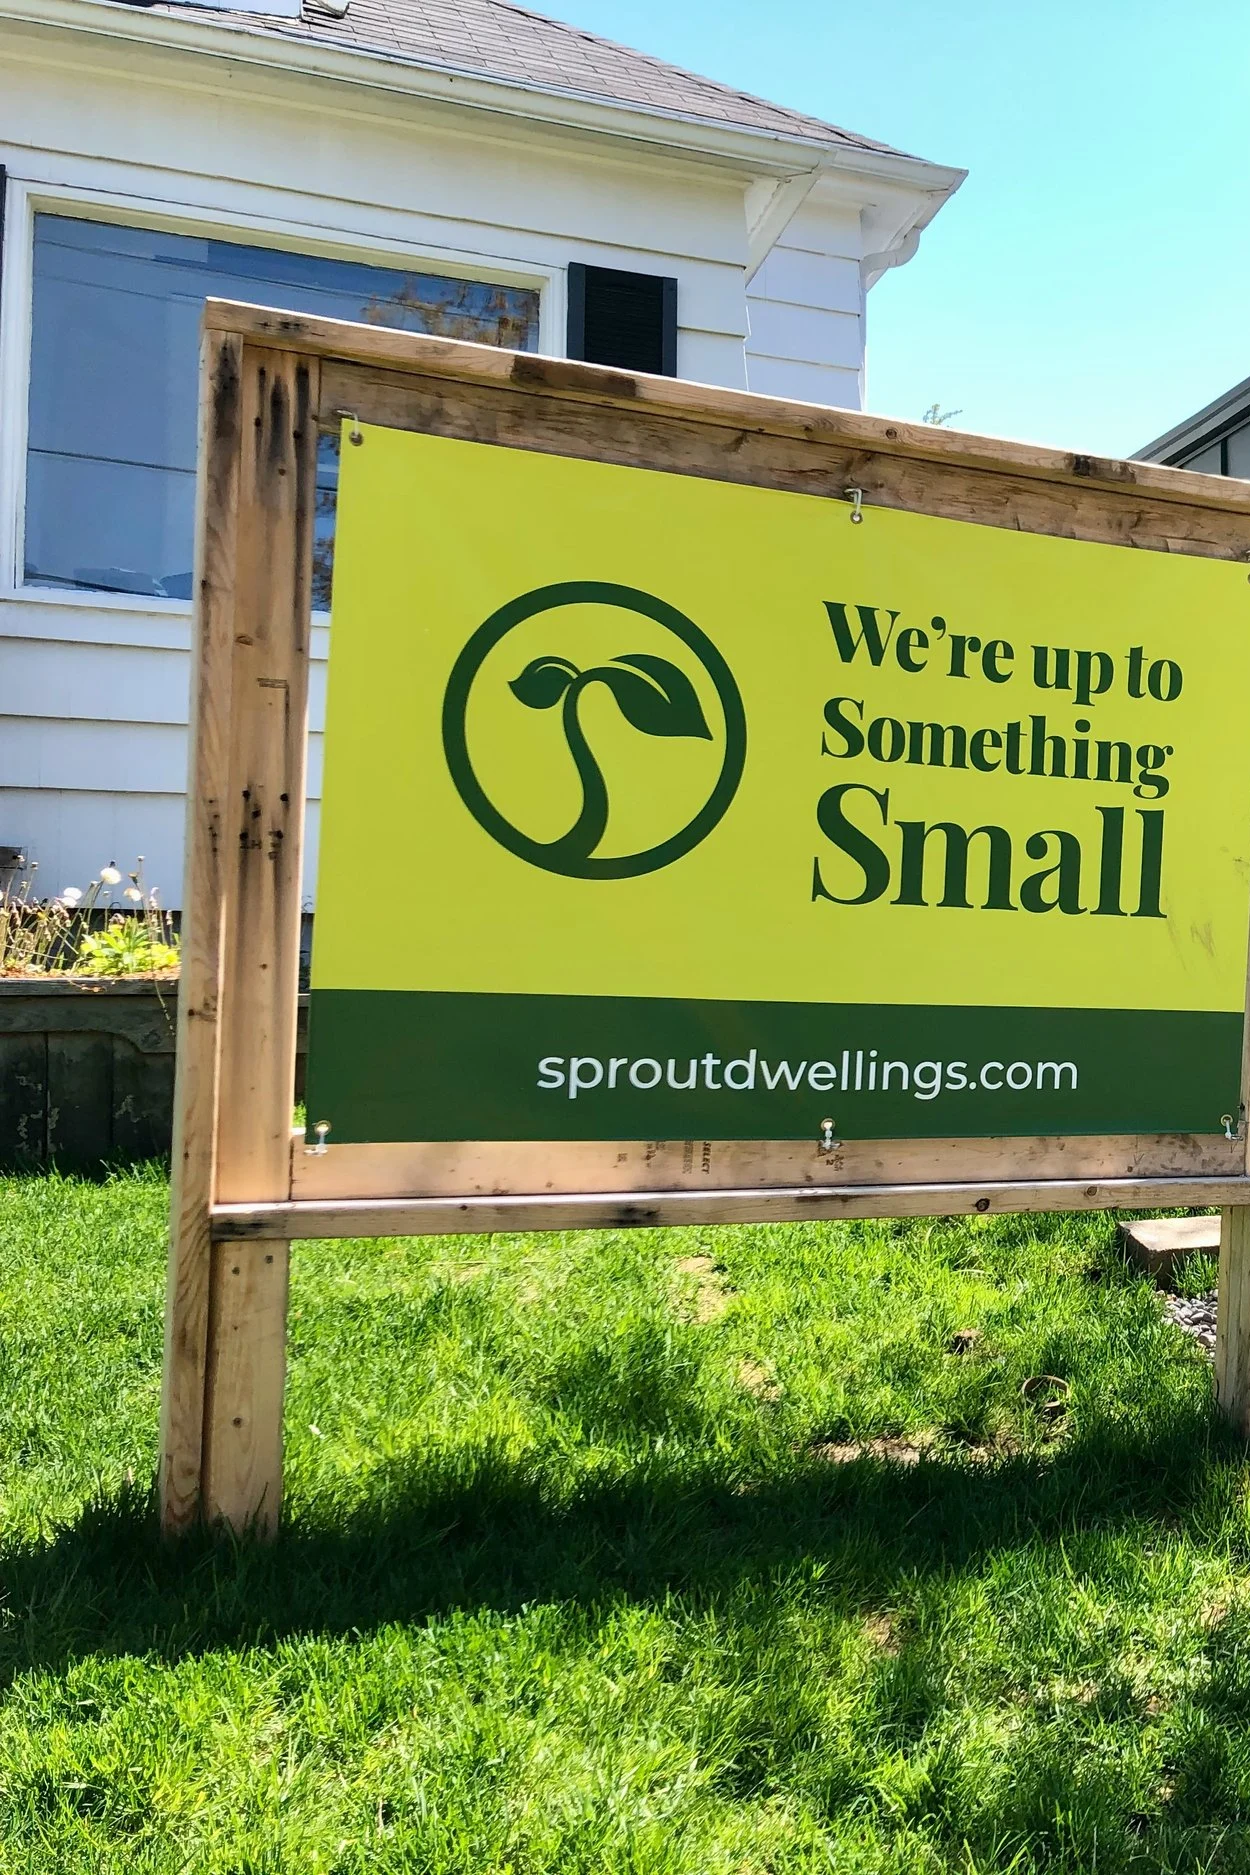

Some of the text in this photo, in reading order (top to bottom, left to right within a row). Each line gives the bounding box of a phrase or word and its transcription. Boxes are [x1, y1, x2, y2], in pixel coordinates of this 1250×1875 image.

[822, 601, 1183, 707] We’re up to
[821, 696, 1174, 800] Something
[811, 783, 1168, 919] Small
[536, 1048, 1079, 1100] sproutdwellings.com
[701, 1141, 712, 1175] SELECT
